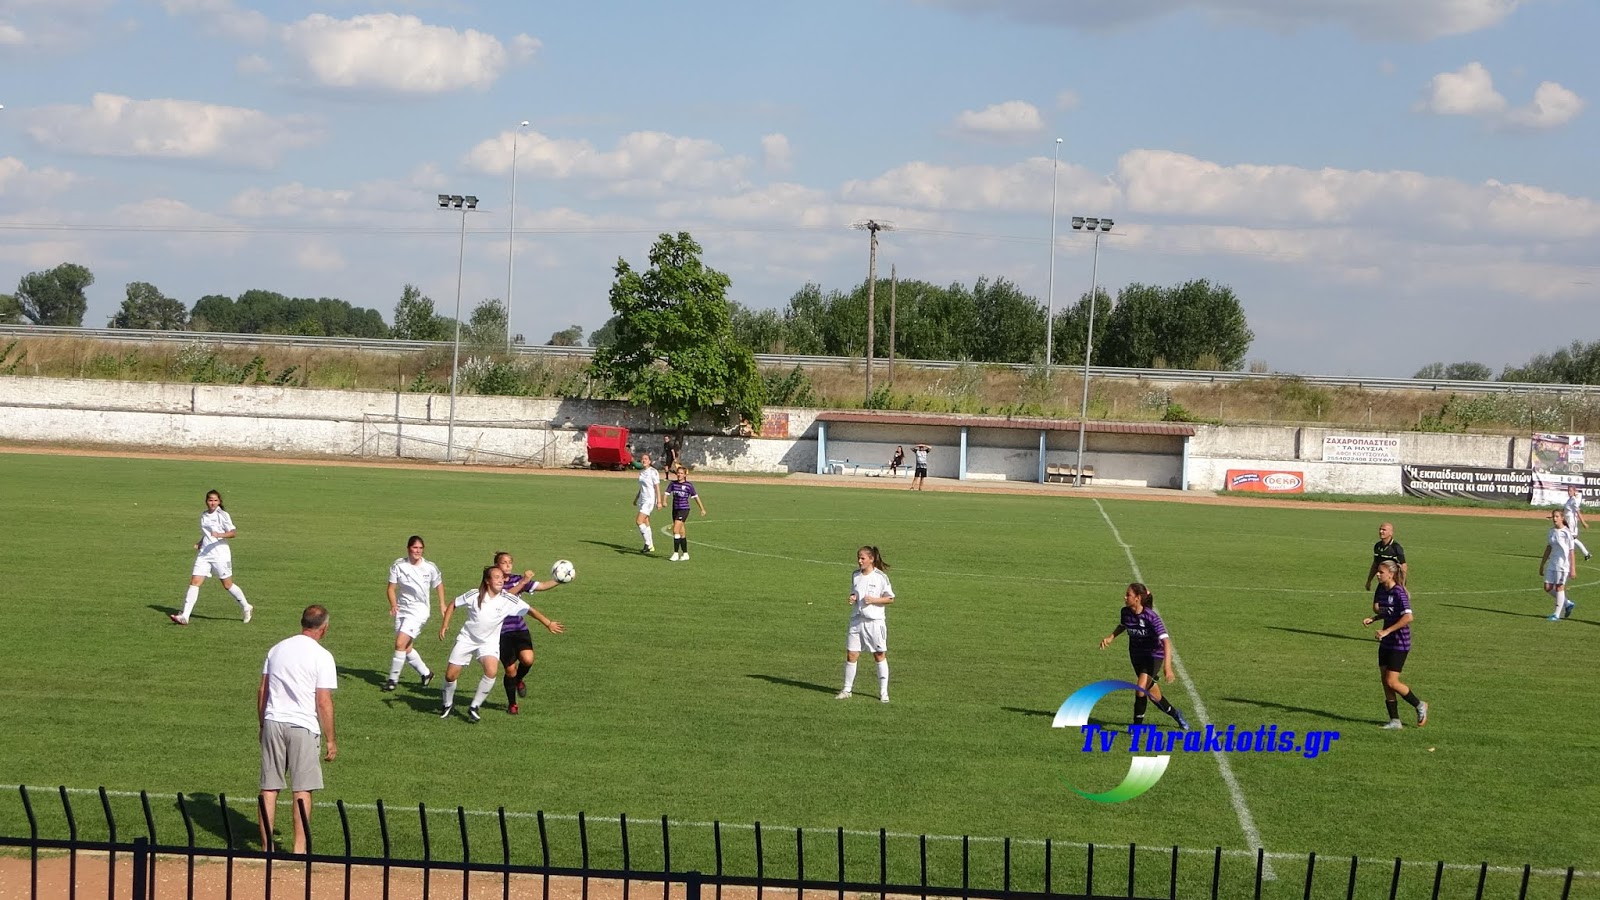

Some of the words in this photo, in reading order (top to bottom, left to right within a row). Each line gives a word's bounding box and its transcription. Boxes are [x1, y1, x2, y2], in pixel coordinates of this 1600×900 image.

[1326, 438, 1397, 447] ΖΑΧΑΡΟΠΛΑΣΤΕΙΟ
[1268, 477, 1296, 485] DEKA
[1419, 469, 1474, 482] εκπαίδευση
[1475, 473, 1494, 481] των
[1494, 471, 1532, 483] παιδιών
[1466, 483, 1475, 492] κι
[1476, 482, 1495, 493] από
[1496, 484, 1508, 493] τα
